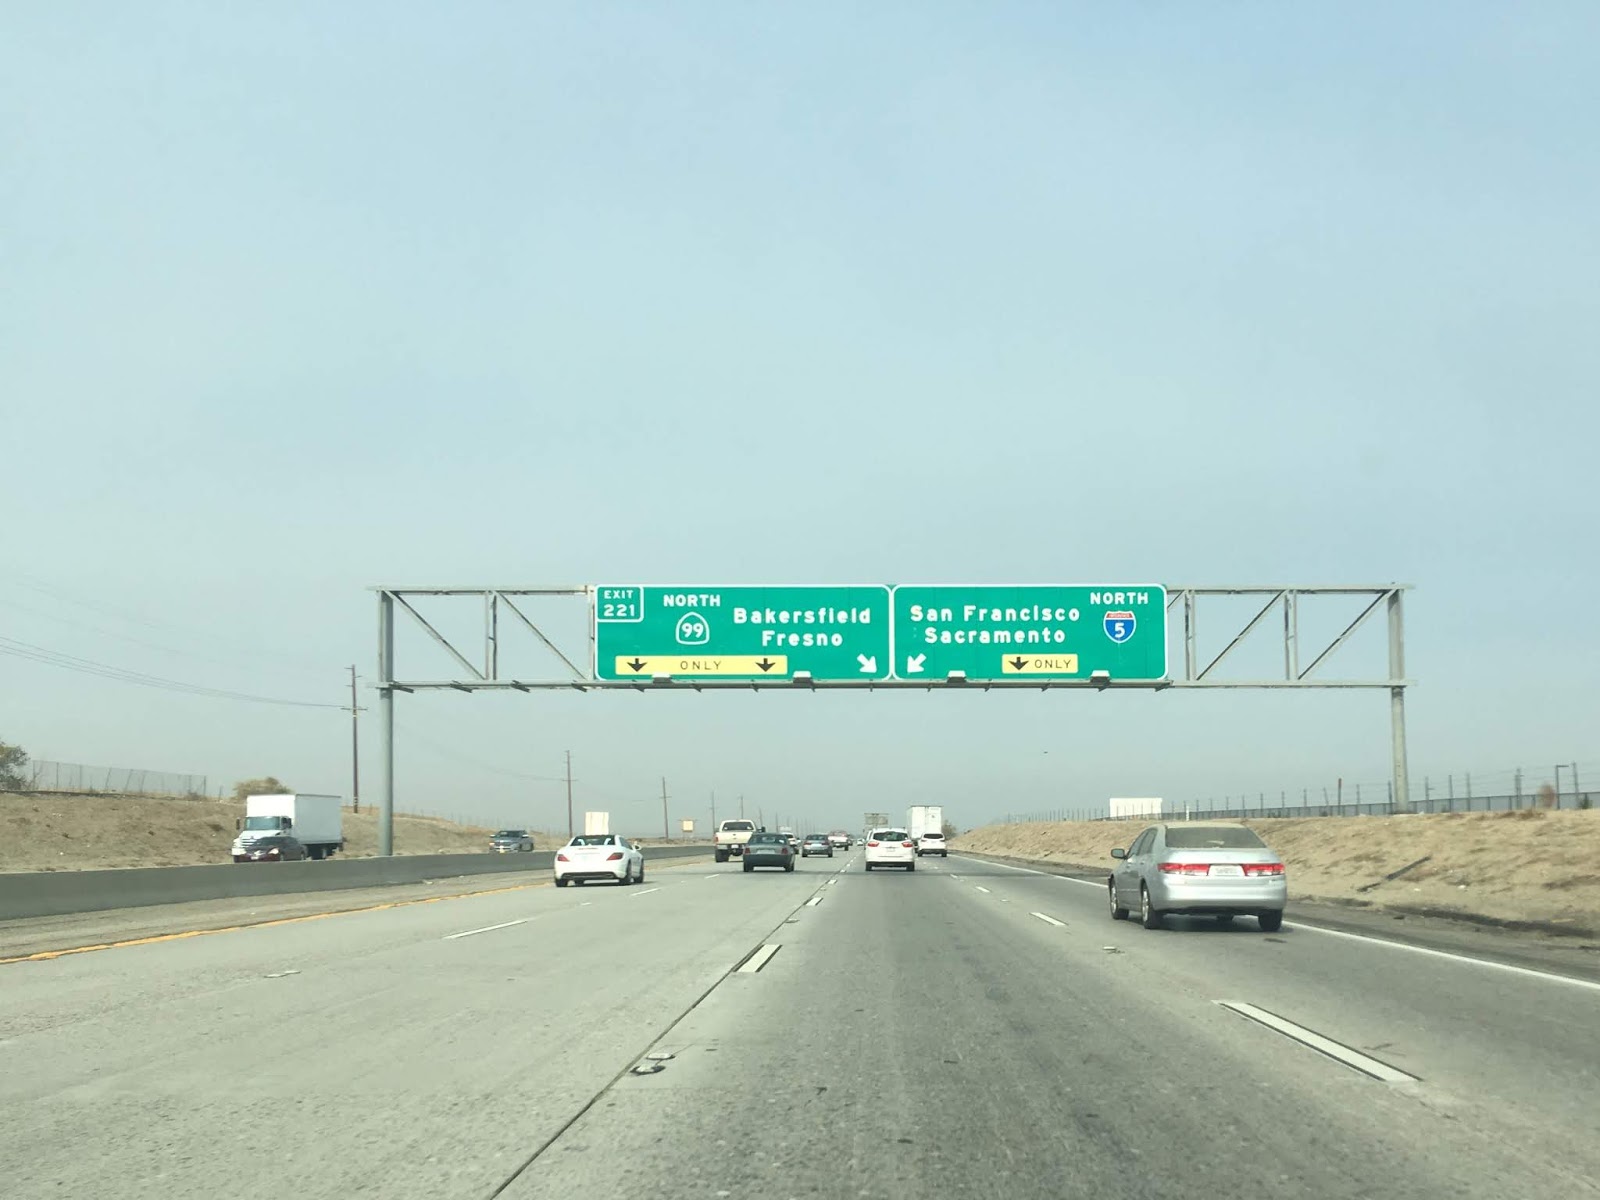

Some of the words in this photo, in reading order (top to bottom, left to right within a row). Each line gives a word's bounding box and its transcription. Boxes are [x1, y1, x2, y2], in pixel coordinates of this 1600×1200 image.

[604, 590, 633, 599] EXIT
[663, 594, 721, 607] NORTH
[1089, 592, 1149, 605] NORTH
[603, 604, 635, 617] 221
[733, 607, 871, 624] Bakersfield
[910, 605, 952, 622] San
[963, 605, 1080, 622] Francisco
[681, 623, 704, 638] 99
[924, 627, 1066, 644] Sacramento
[1114, 622, 1126, 638] 5
[762, 630, 843, 647] Fresno
[680, 660, 722, 671] ONLY
[1034, 659, 1072, 670] ONLY
